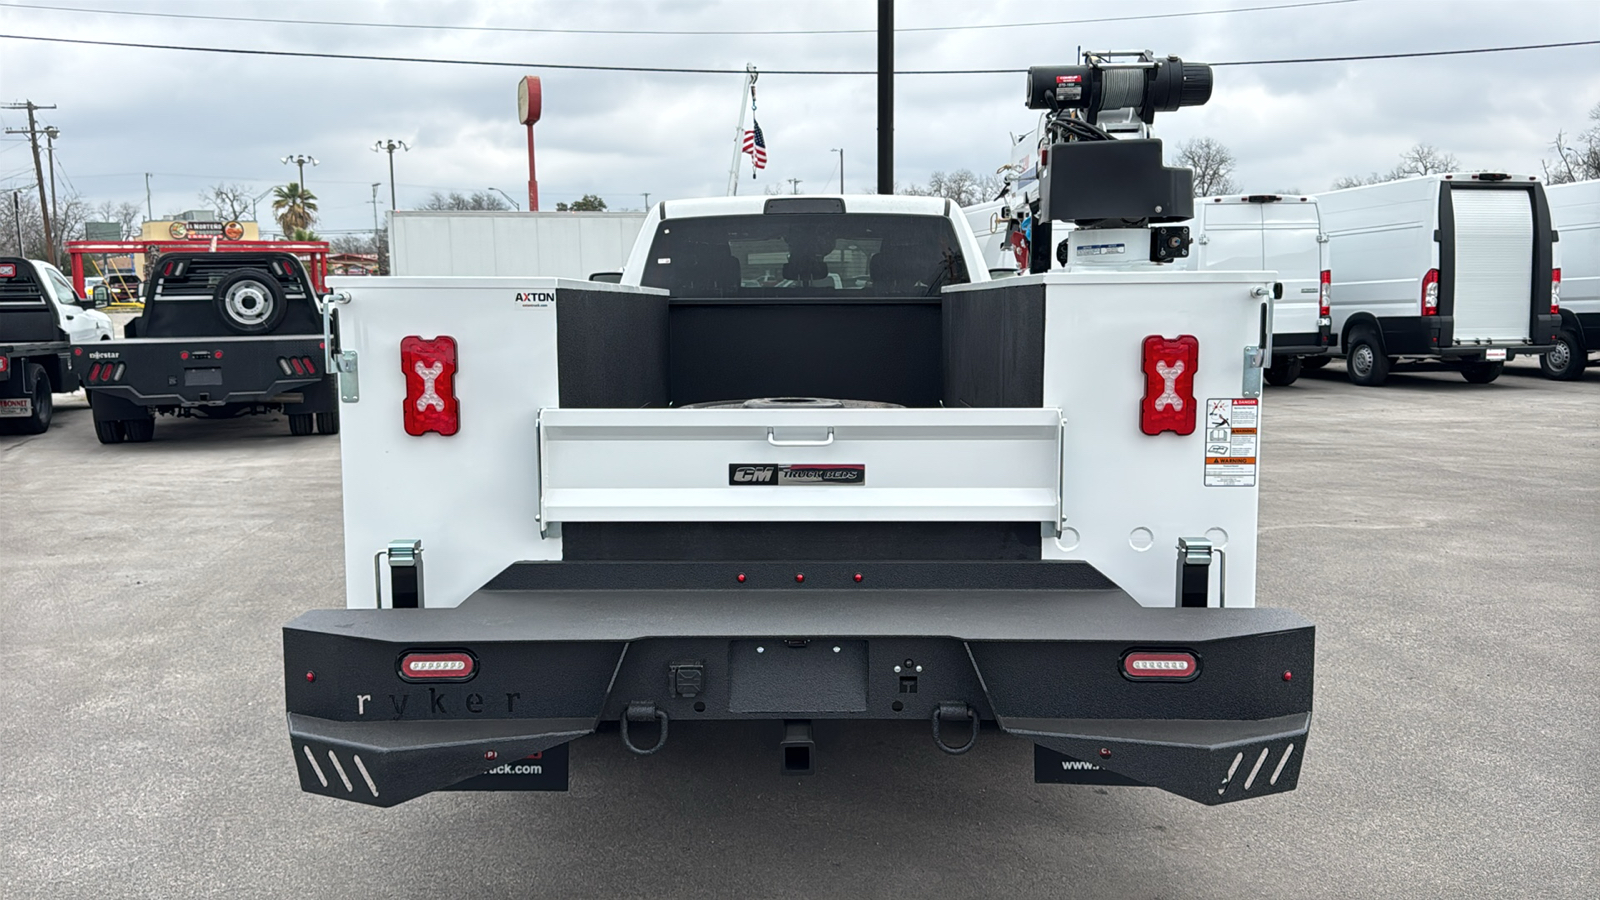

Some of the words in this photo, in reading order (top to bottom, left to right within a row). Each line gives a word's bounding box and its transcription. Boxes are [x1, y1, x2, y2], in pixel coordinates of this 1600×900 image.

[515, 292, 555, 302] AXTON
[782, 469, 823, 479] TRUCK
[823, 470, 858, 480] BEDS
[357, 687, 520, 720] ryker
